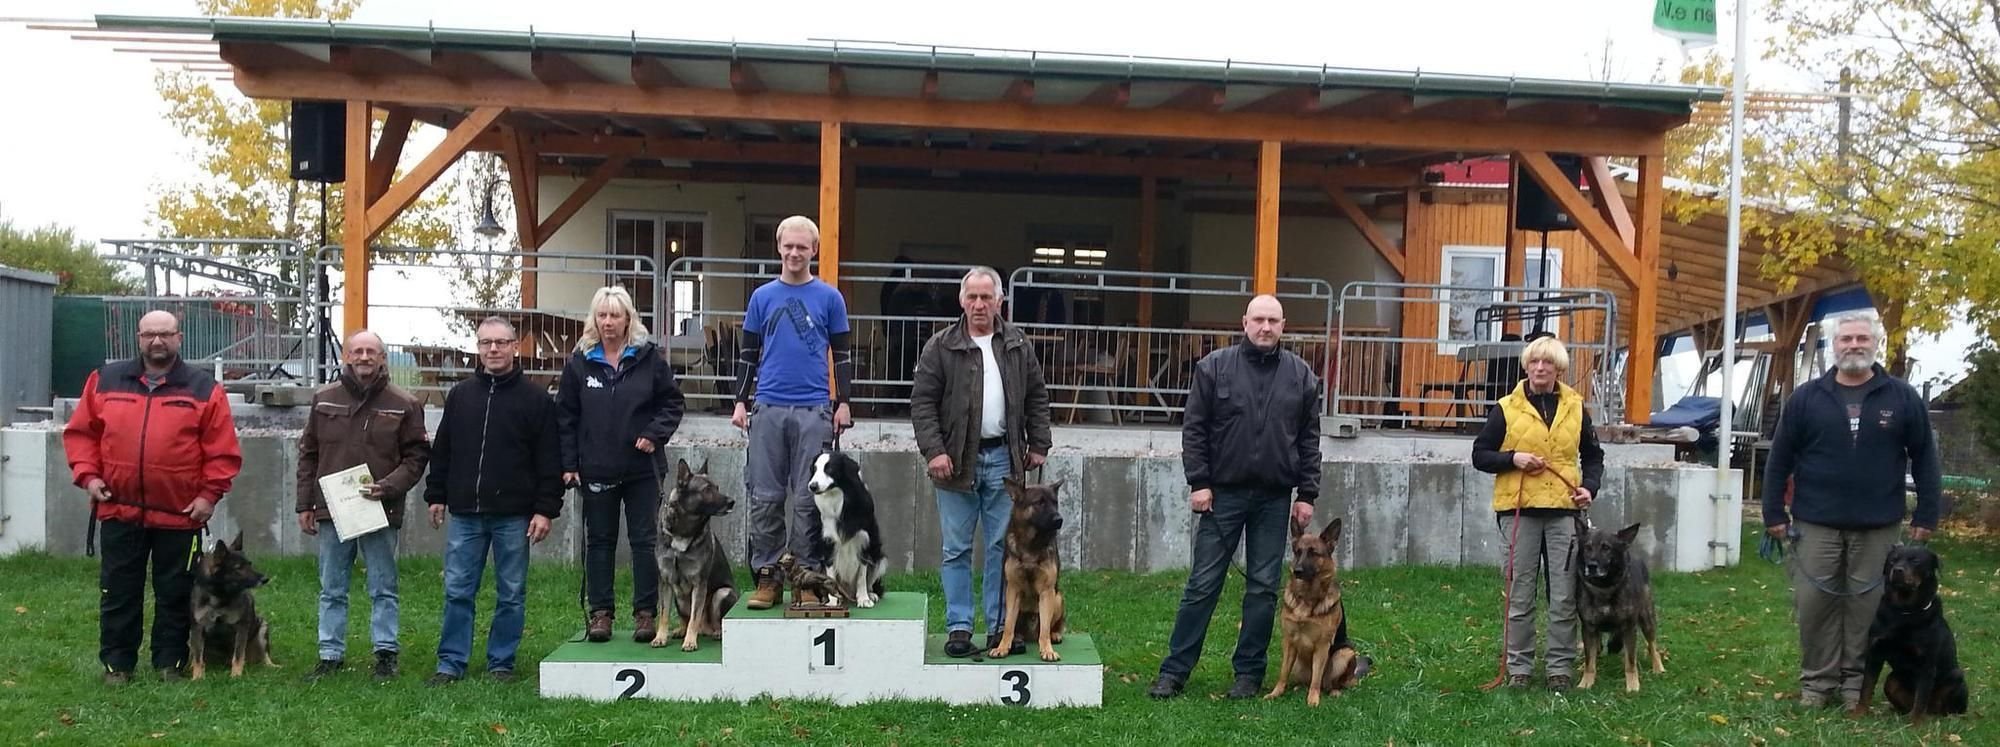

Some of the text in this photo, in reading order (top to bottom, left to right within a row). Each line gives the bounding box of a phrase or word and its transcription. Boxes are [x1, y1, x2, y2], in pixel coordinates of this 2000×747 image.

[813, 628, 836, 666] 1
[615, 669, 646, 701] 2
[1000, 670, 1031, 707] 3
